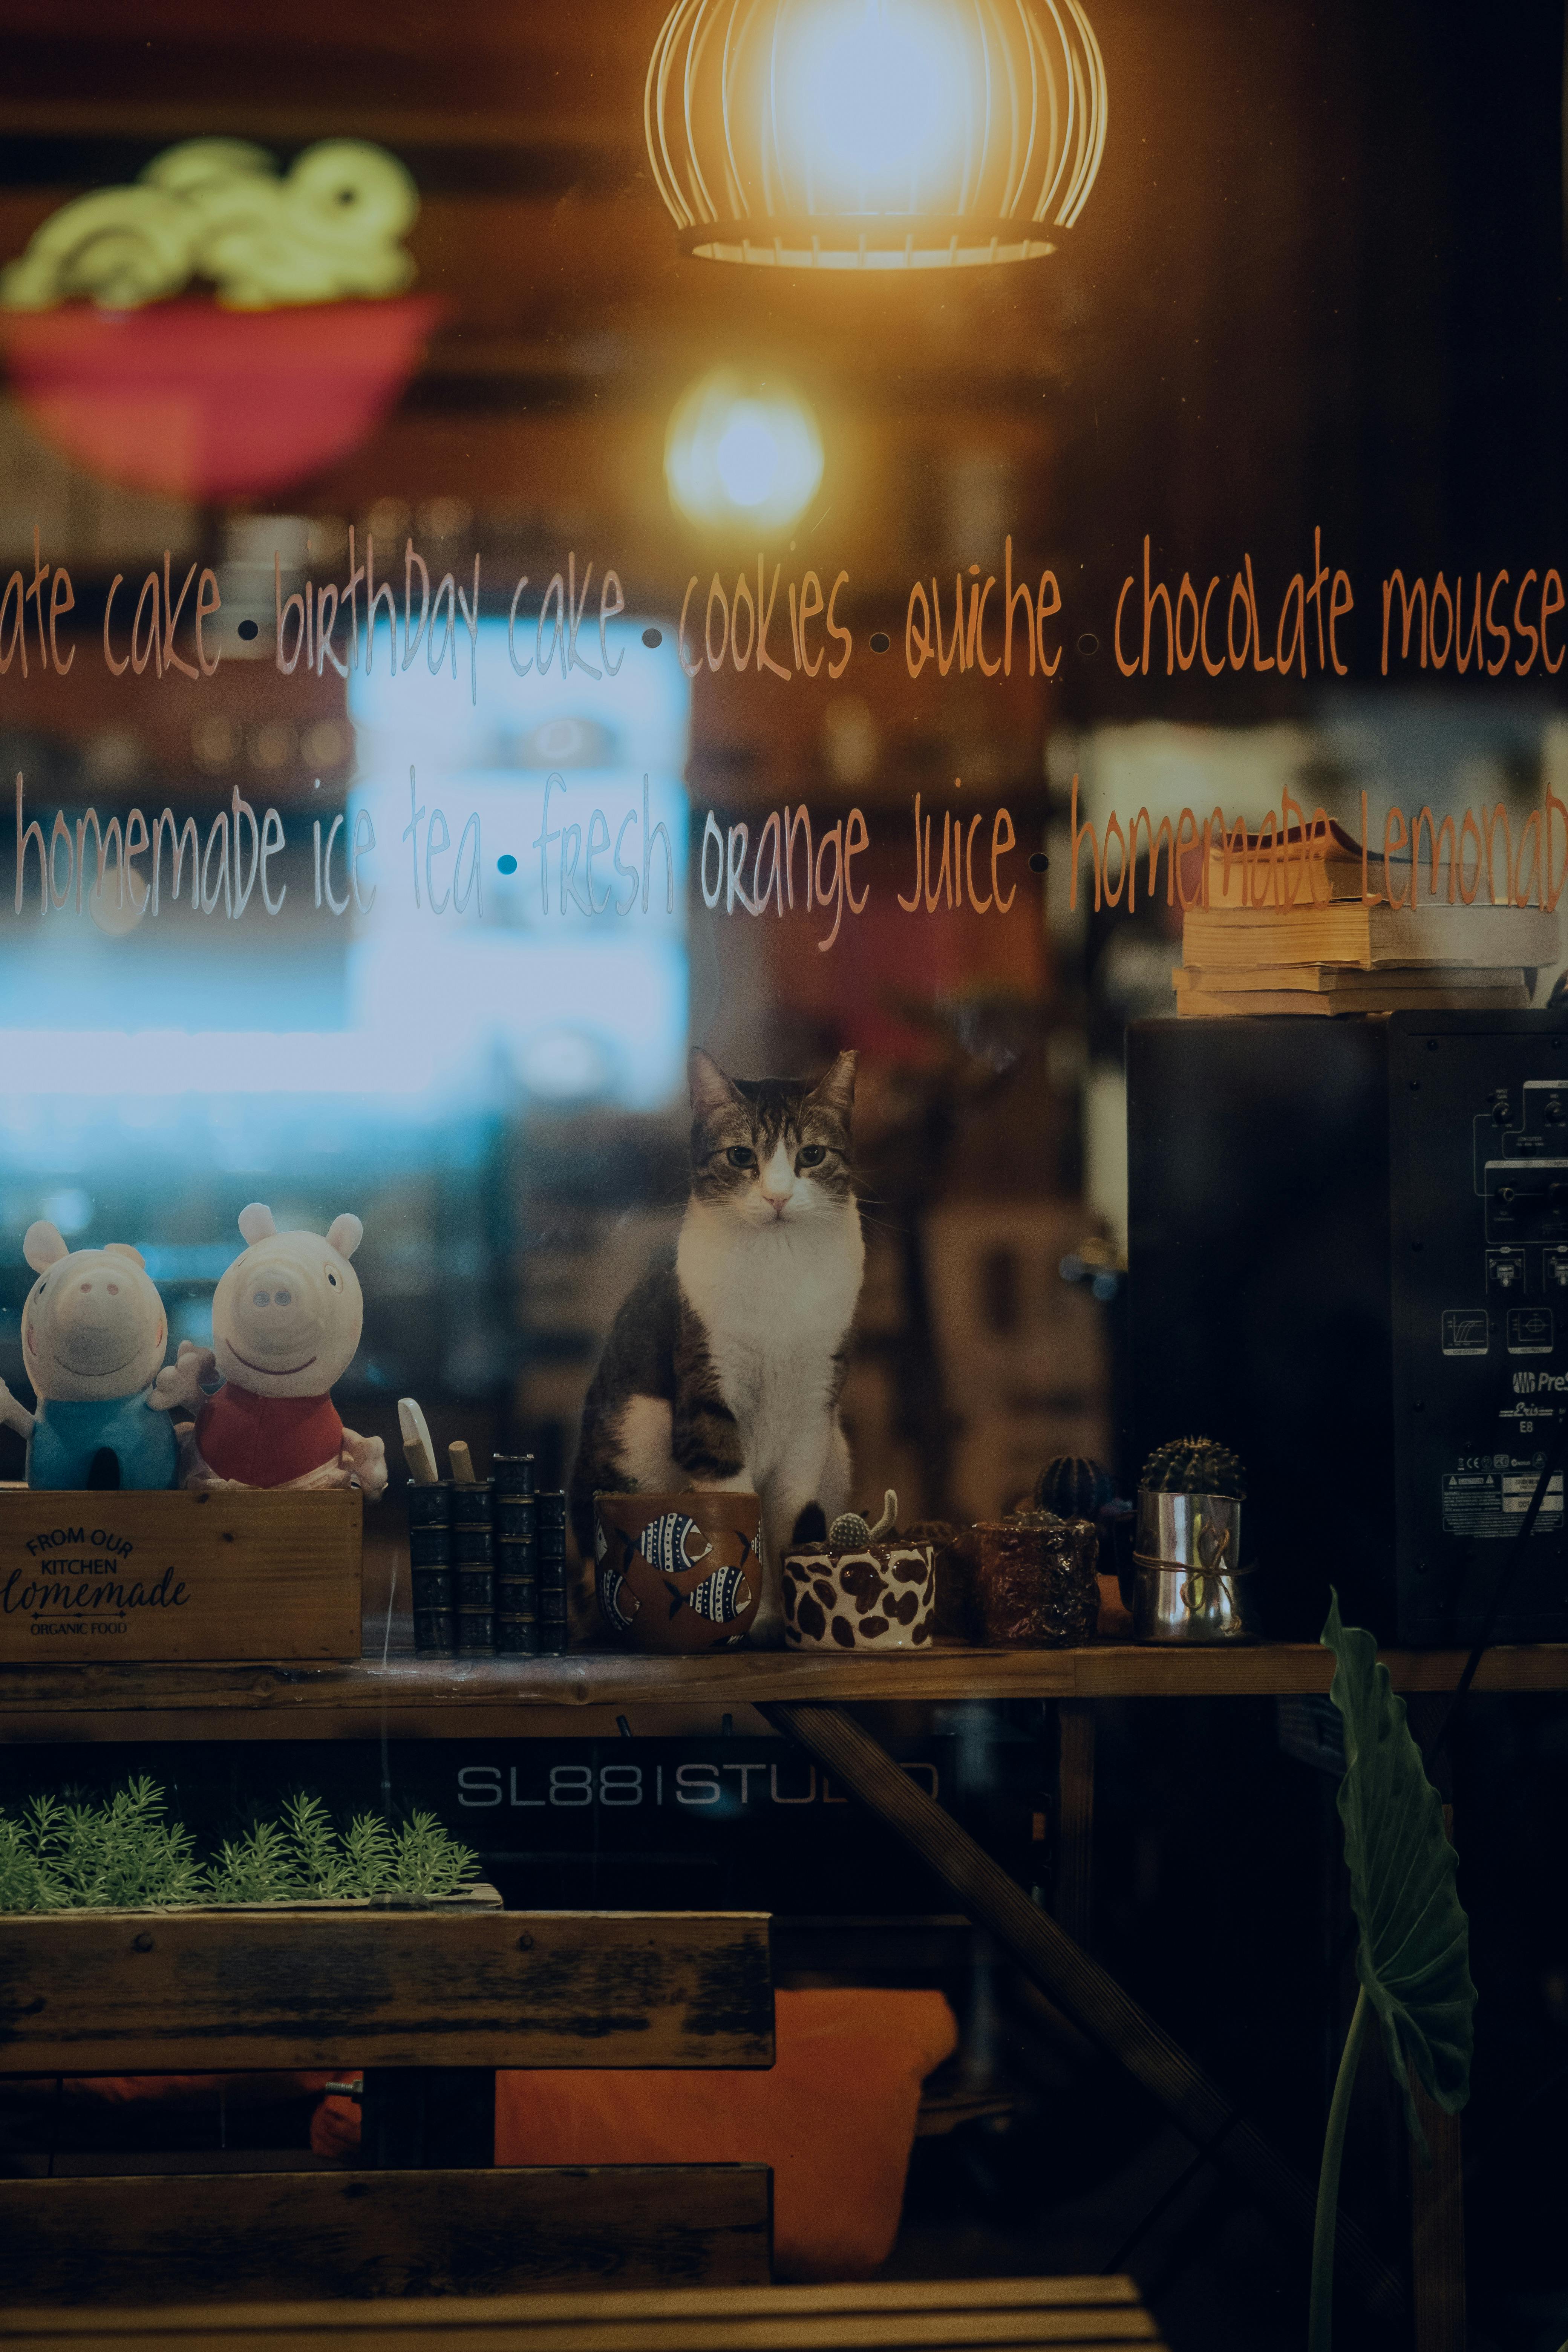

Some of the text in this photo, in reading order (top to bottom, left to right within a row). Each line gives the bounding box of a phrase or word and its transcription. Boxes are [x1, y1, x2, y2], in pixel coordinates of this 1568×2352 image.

[103, 549, 222, 679] cake
[508, 551, 625, 680] cake
[679, 540, 852, 681] cookies
[1382, 568, 1566, 676] mousse
[313, 778, 377, 916] ice
[402, 764, 483, 918] tea
[1519, 1421, 1533, 1433] E8
[26, 1527, 133, 1559] FROM OUR
[41, 1559, 117, 1575] KITCHEN
[31, 1622, 127, 1635] ORGANIC FOOD
